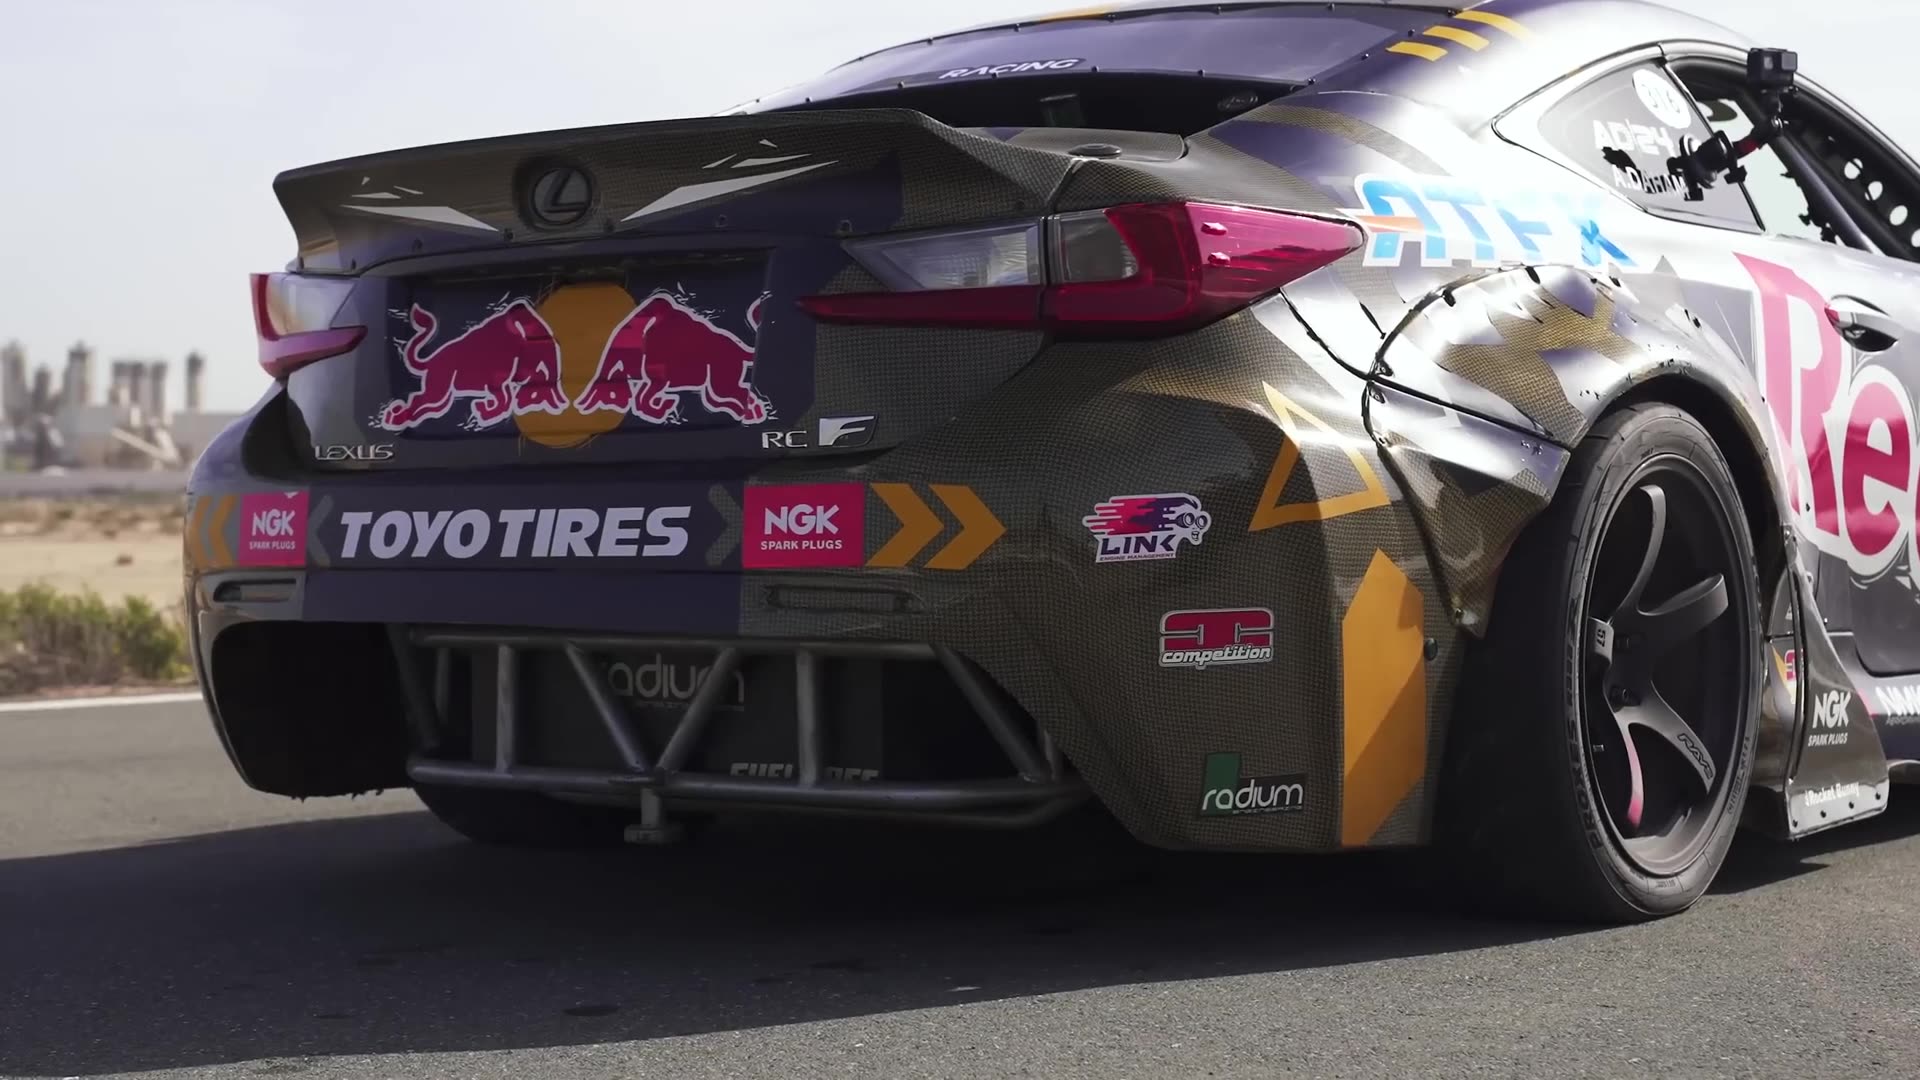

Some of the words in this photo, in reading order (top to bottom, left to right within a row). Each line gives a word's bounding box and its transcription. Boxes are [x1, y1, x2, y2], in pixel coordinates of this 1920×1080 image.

[938, 58, 1079, 79] RACING
[1731, 250, 1920, 556] Re
[762, 430, 807, 448] RC
[314, 444, 394, 460] LEXUS
[252, 509, 295, 536] NGK
[764, 504, 840, 535] NGK
[340, 509, 491, 559] TOYO
[498, 506, 691, 558] TIRES
[249, 541, 270, 550] SPARK
[271, 541, 295, 550] PLUGS
[761, 540, 799, 550] SPARK
[801, 540, 842, 550] PLUGS
[1101, 534, 1176, 555] LINK
[1161, 645, 1271, 666] competition
[603, 653, 745, 703] adiu
[1812, 690, 1851, 728] NGK
[1808, 735, 1828, 747] SPARK
[1829, 733, 1848, 745] PLUGS
[1202, 779, 1303, 810] radium
